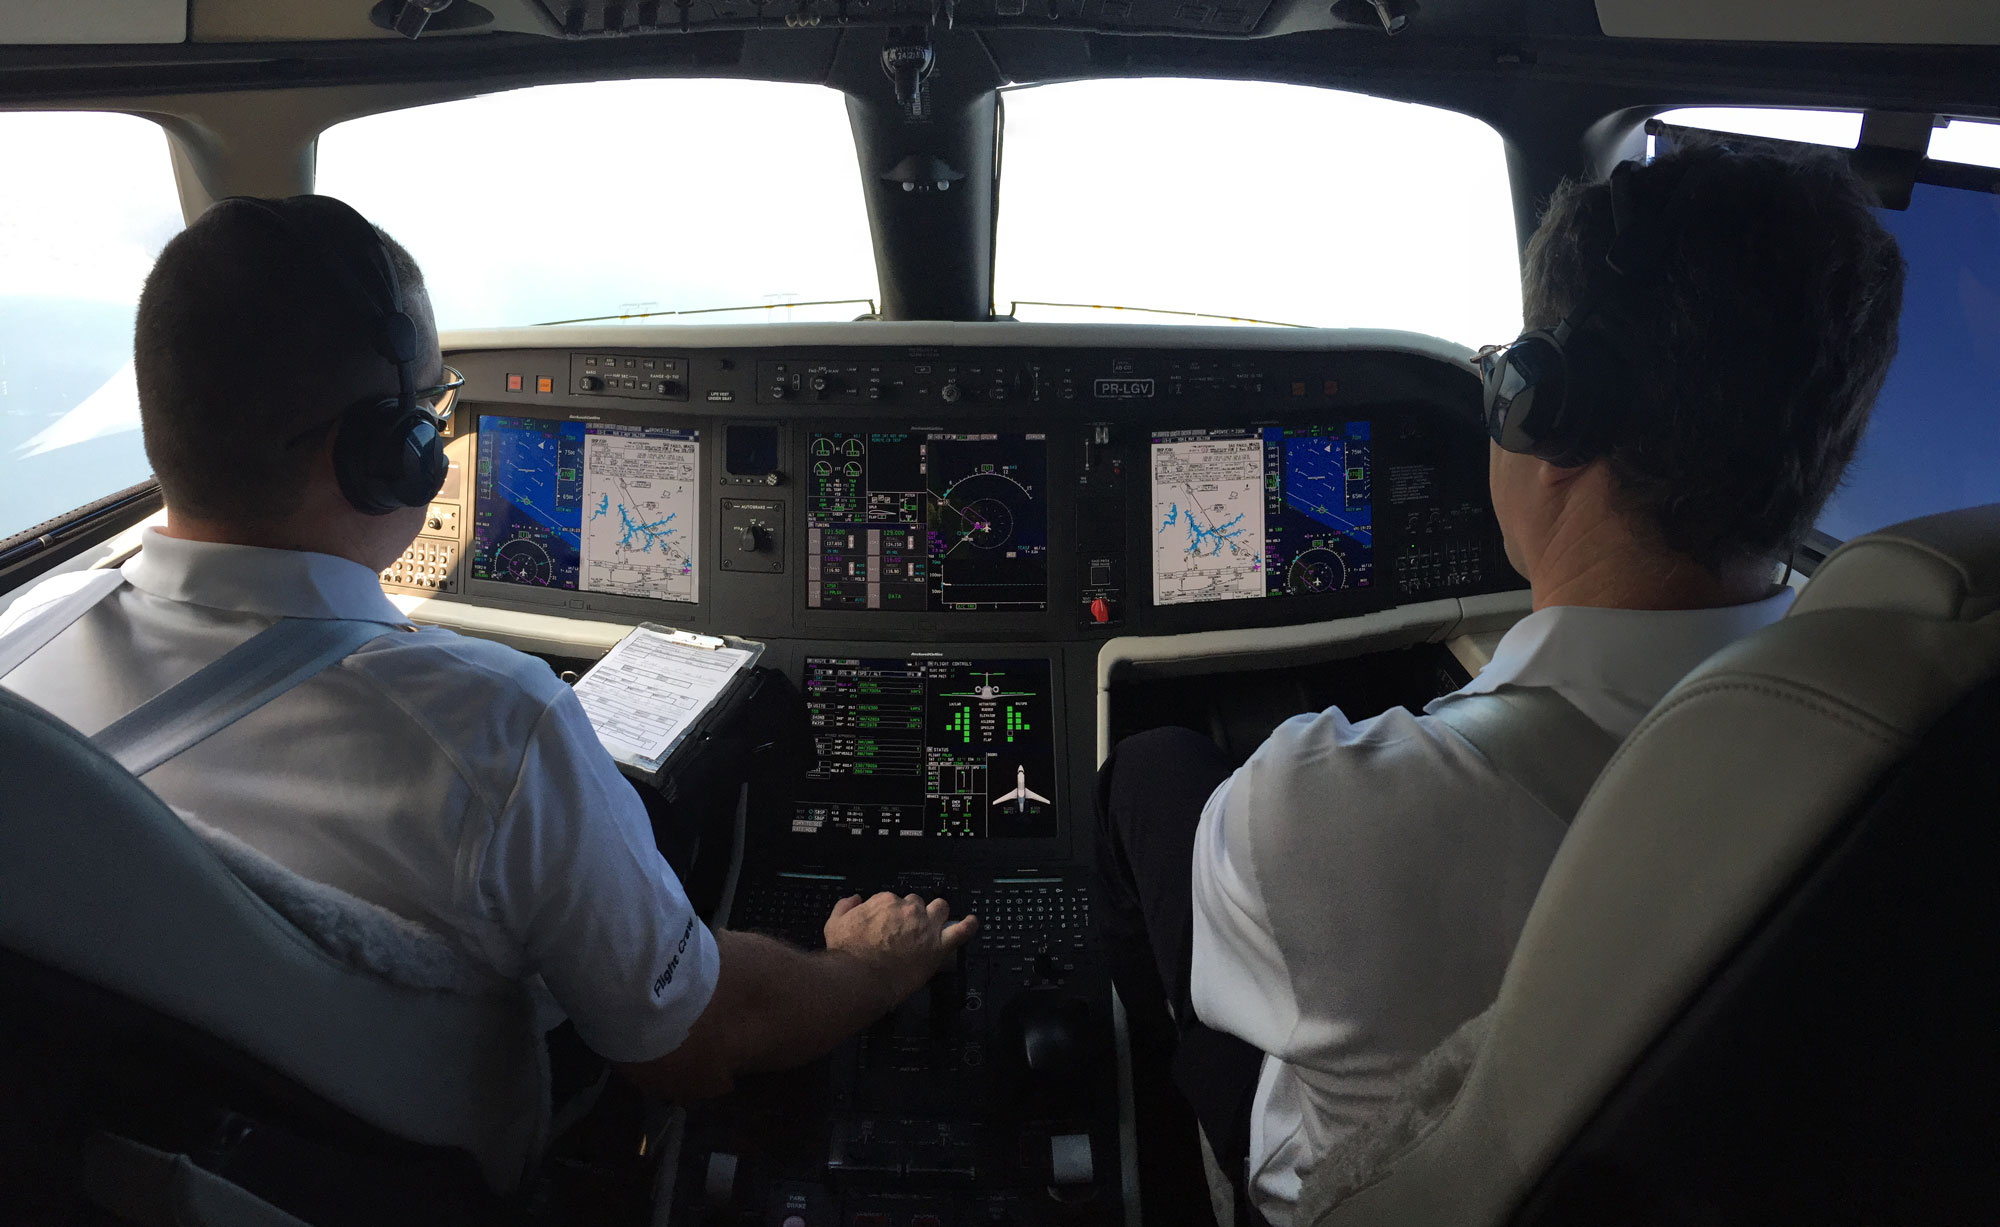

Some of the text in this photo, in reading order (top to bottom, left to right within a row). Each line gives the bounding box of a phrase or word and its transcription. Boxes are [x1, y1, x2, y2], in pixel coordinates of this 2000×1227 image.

[1102, 383, 1150, 394] PR-LGV
[654, 918, 693, 997] Flight Crew
[789, 1195, 806, 1203] PARK
